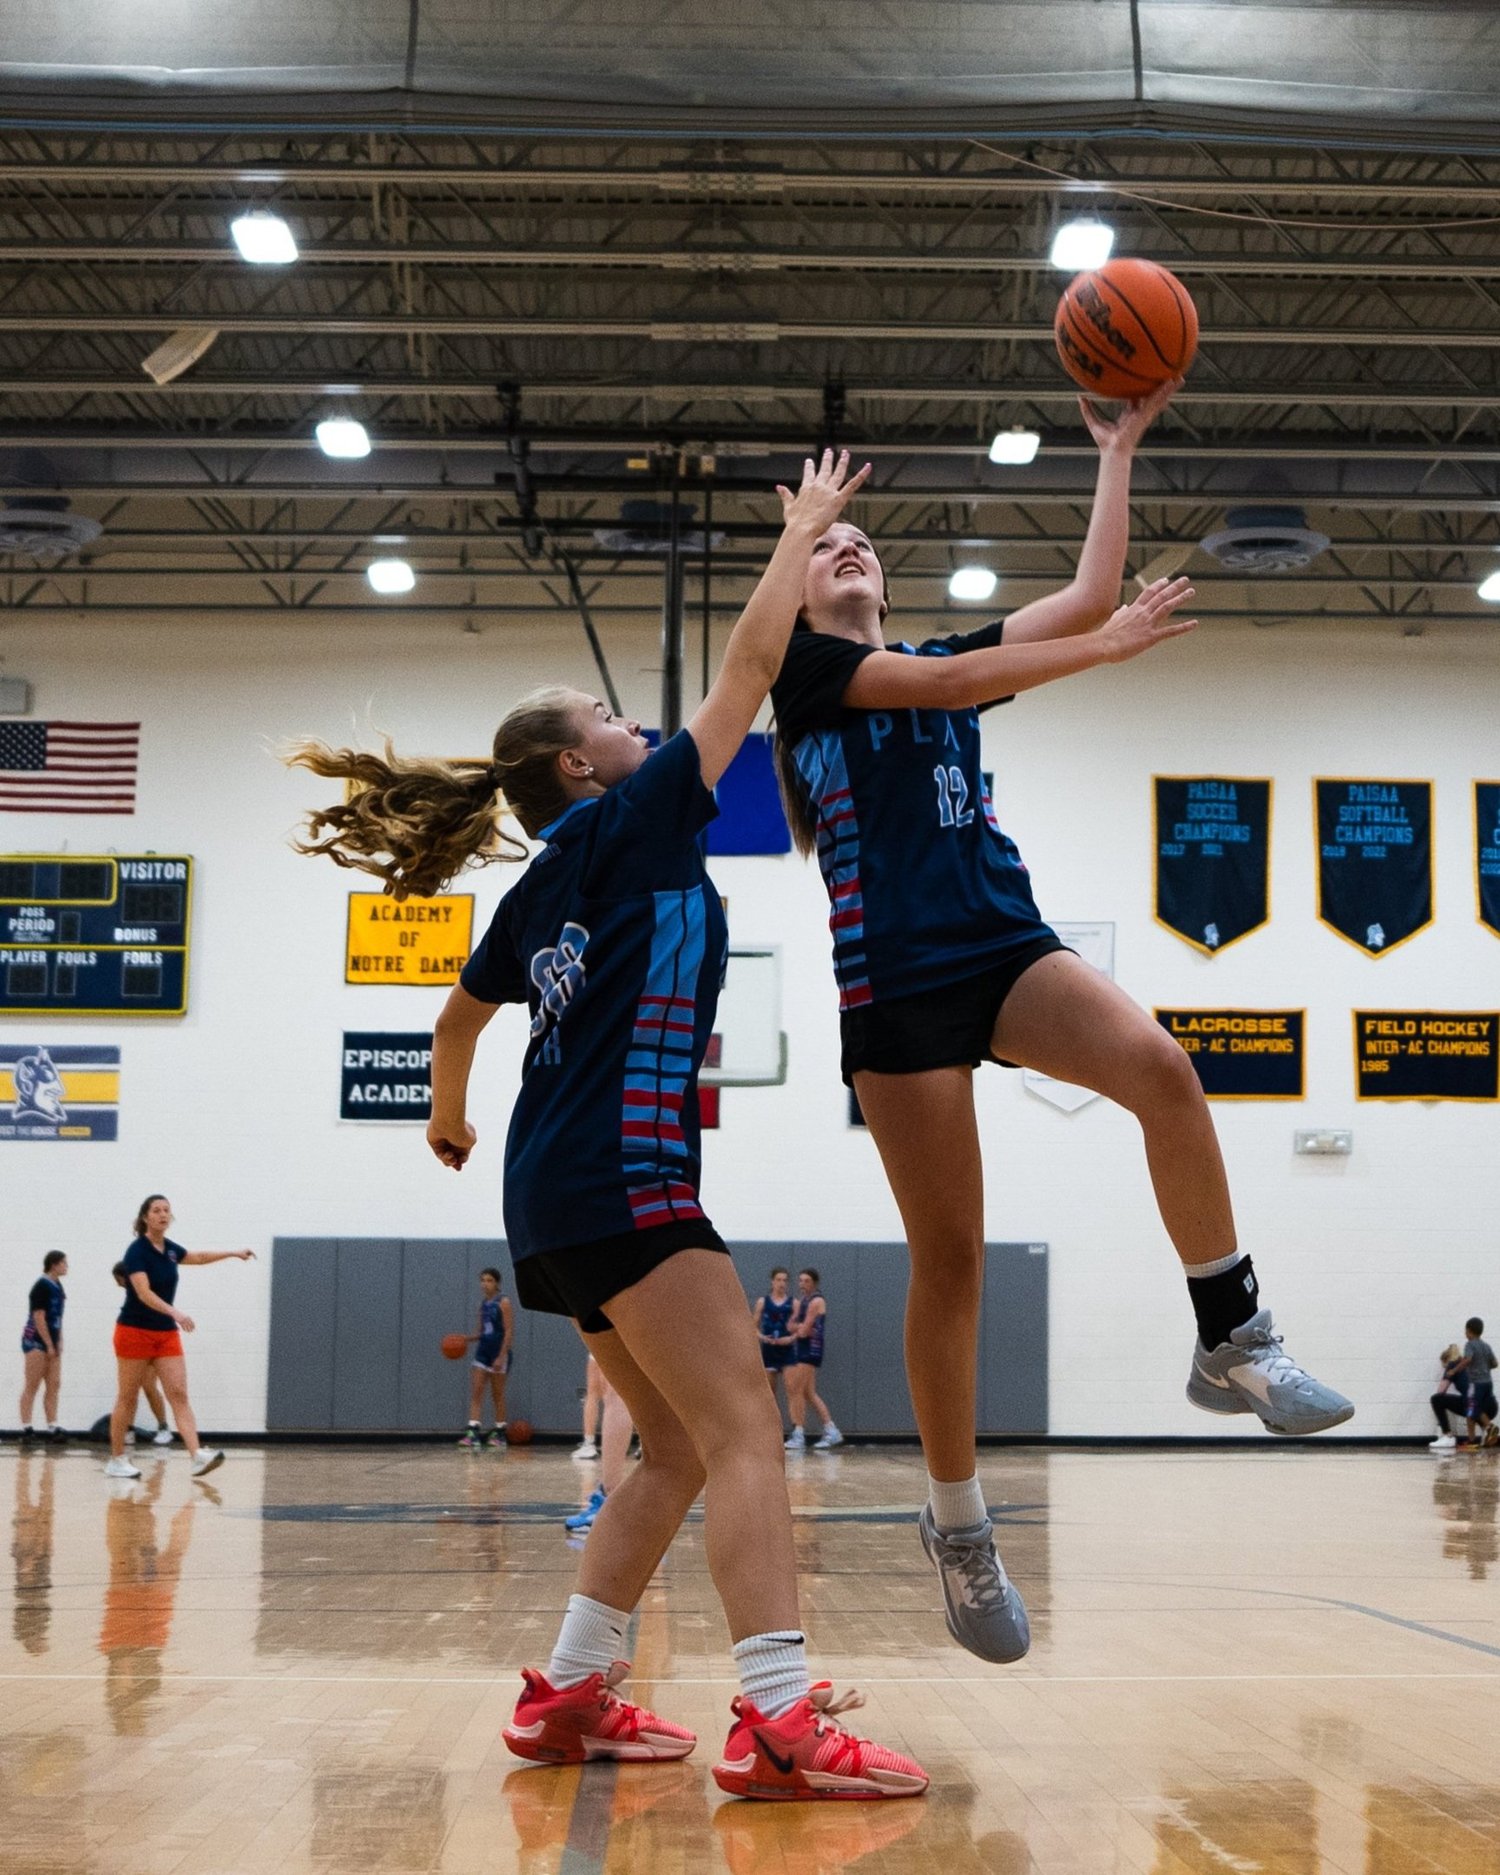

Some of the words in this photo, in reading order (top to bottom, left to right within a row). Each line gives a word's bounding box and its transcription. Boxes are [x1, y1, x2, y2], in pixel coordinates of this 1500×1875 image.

[934, 764, 975, 828] 12
[1339, 805, 1409, 823] SOFTBALL
[1174, 822, 1250, 843] CHAMPIONS
[1335, 825, 1413, 844] CHAMPIONS
[120, 862, 187, 880] VISITOR
[20, 906, 46, 917] POSS
[369, 905, 453, 923] ACADEMY
[8, 917, 56, 932] PERIOD
[114, 927, 158, 942] BONUS
[399, 931, 420, 948] OF
[0, 950, 47, 963] PLAYER
[57, 951, 98, 966] FOULS
[123, 951, 163, 965] FOULS
[350, 955, 405, 973] NOTRE
[420, 956, 466, 973] DAME
[1171, 1016, 1287, 1033] LACROSSE
[1365, 1020, 1417, 1035] FIELD
[1421, 1021, 1490, 1036] HOCKEY
[1230, 1038, 1294, 1053] CHAMPIONS
[1427, 1040, 1490, 1055] CHAMPIONS
[343, 1049, 433, 1069] EPISCOP
[348, 1083, 433, 1103] ACADE
